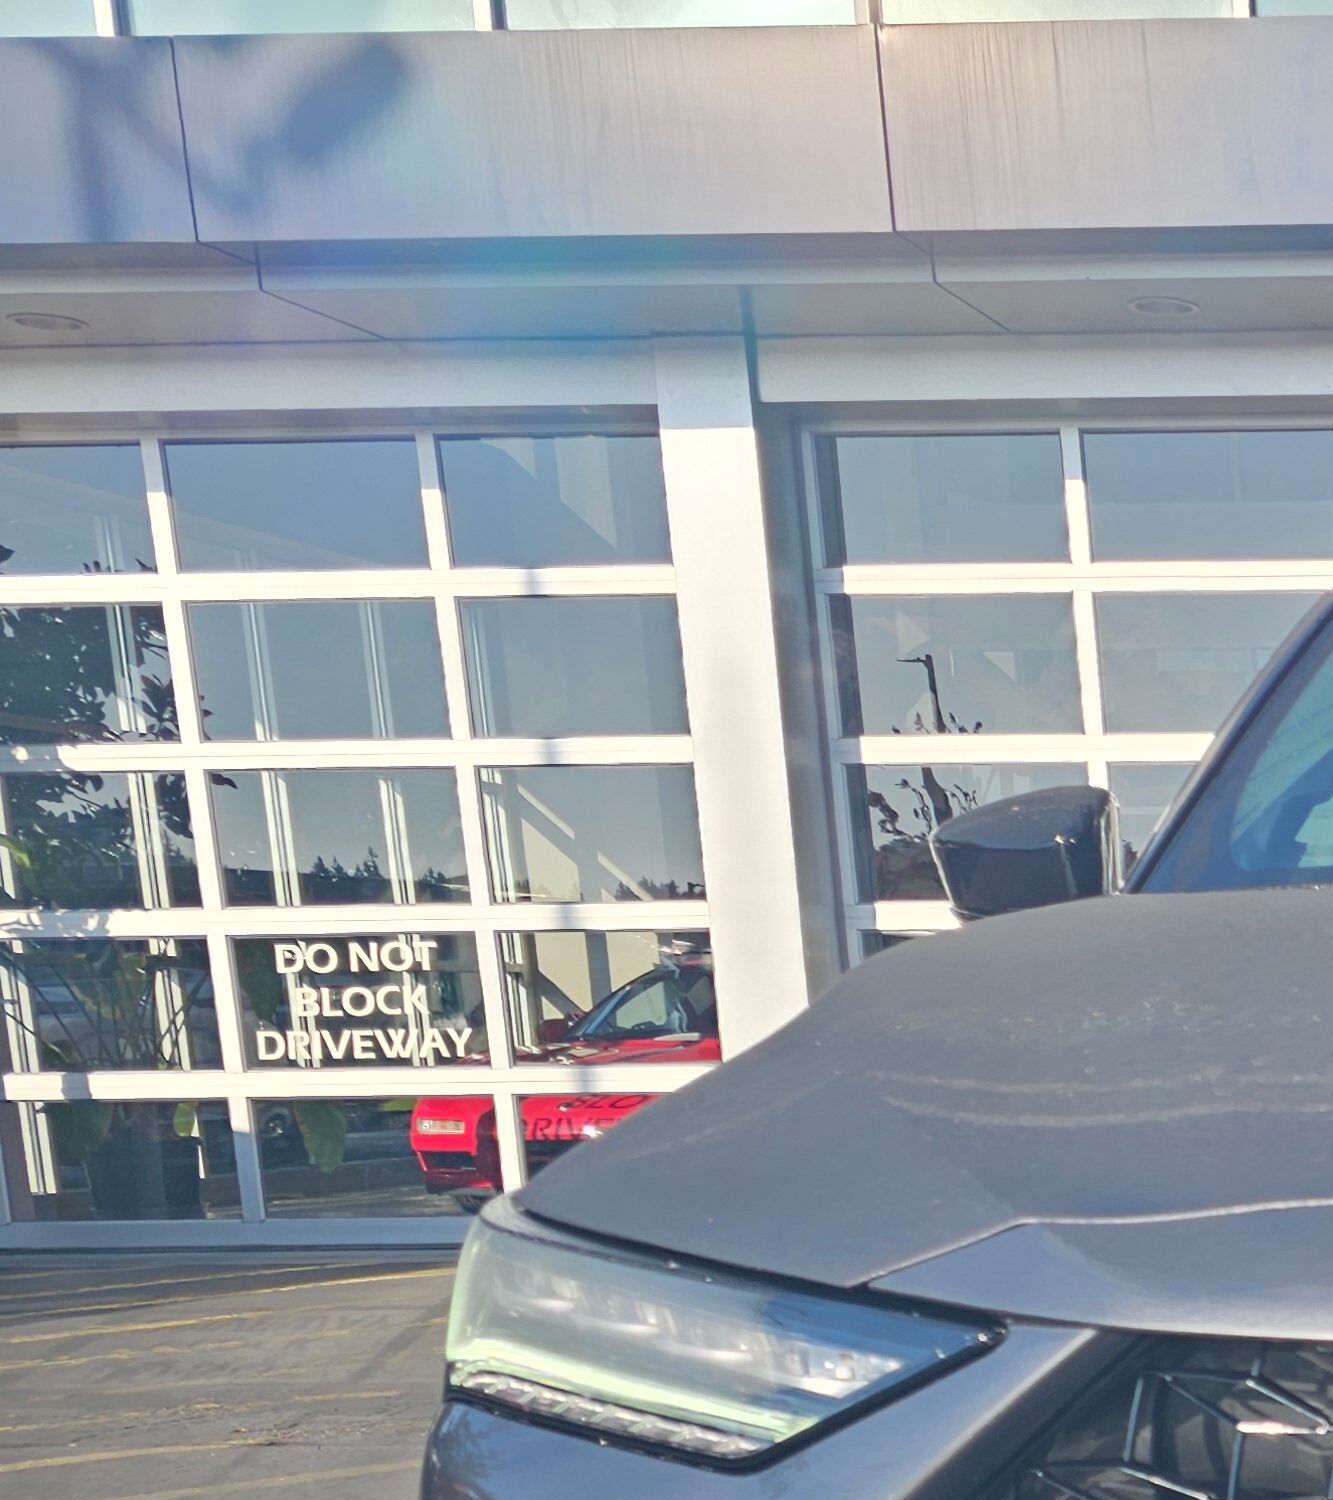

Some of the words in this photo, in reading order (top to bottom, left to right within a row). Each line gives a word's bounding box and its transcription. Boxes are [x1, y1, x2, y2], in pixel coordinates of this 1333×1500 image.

[273, 942, 338, 973] DO
[348, 941, 438, 972] NOT
[296, 984, 430, 1017] BLOCK
[256, 1027, 472, 1061] DRIVEWAY
